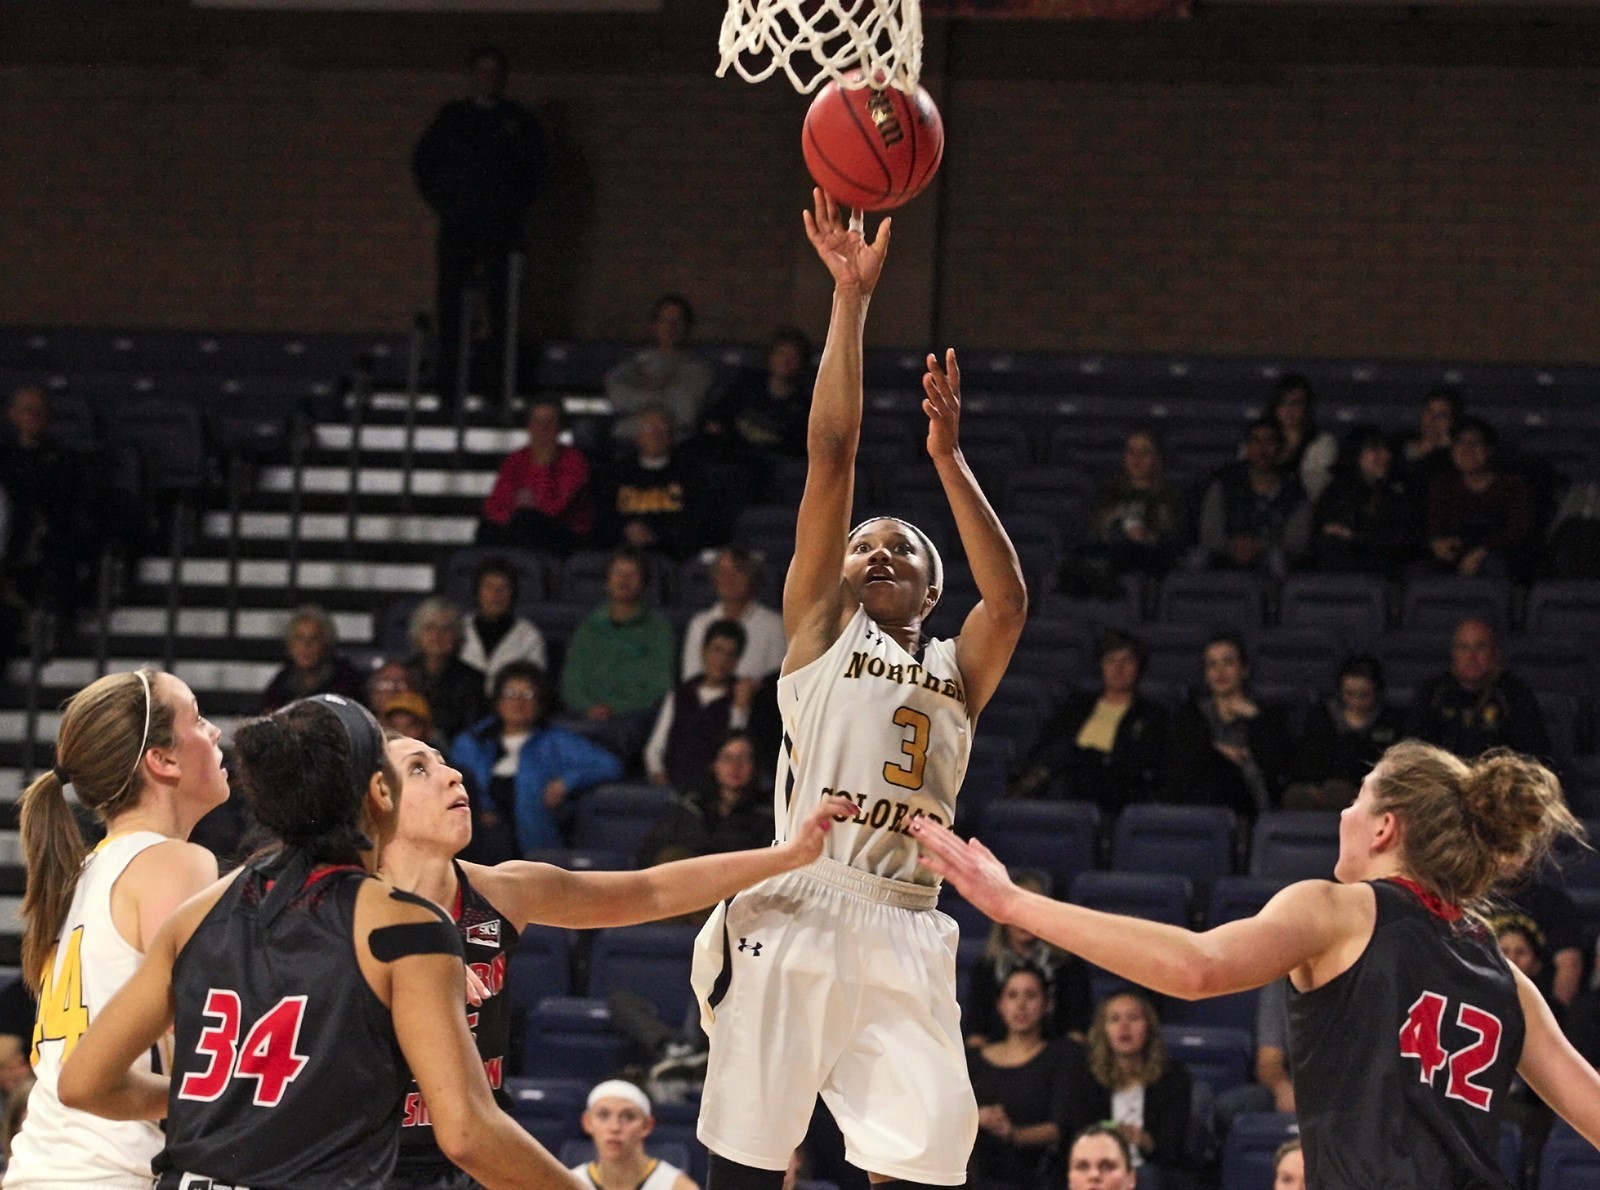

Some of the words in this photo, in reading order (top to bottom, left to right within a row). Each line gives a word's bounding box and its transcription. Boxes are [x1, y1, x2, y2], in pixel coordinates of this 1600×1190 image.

[883, 706, 931, 791] 3
[178, 988, 310, 1107] 34
[1399, 990, 1502, 1112] 42
